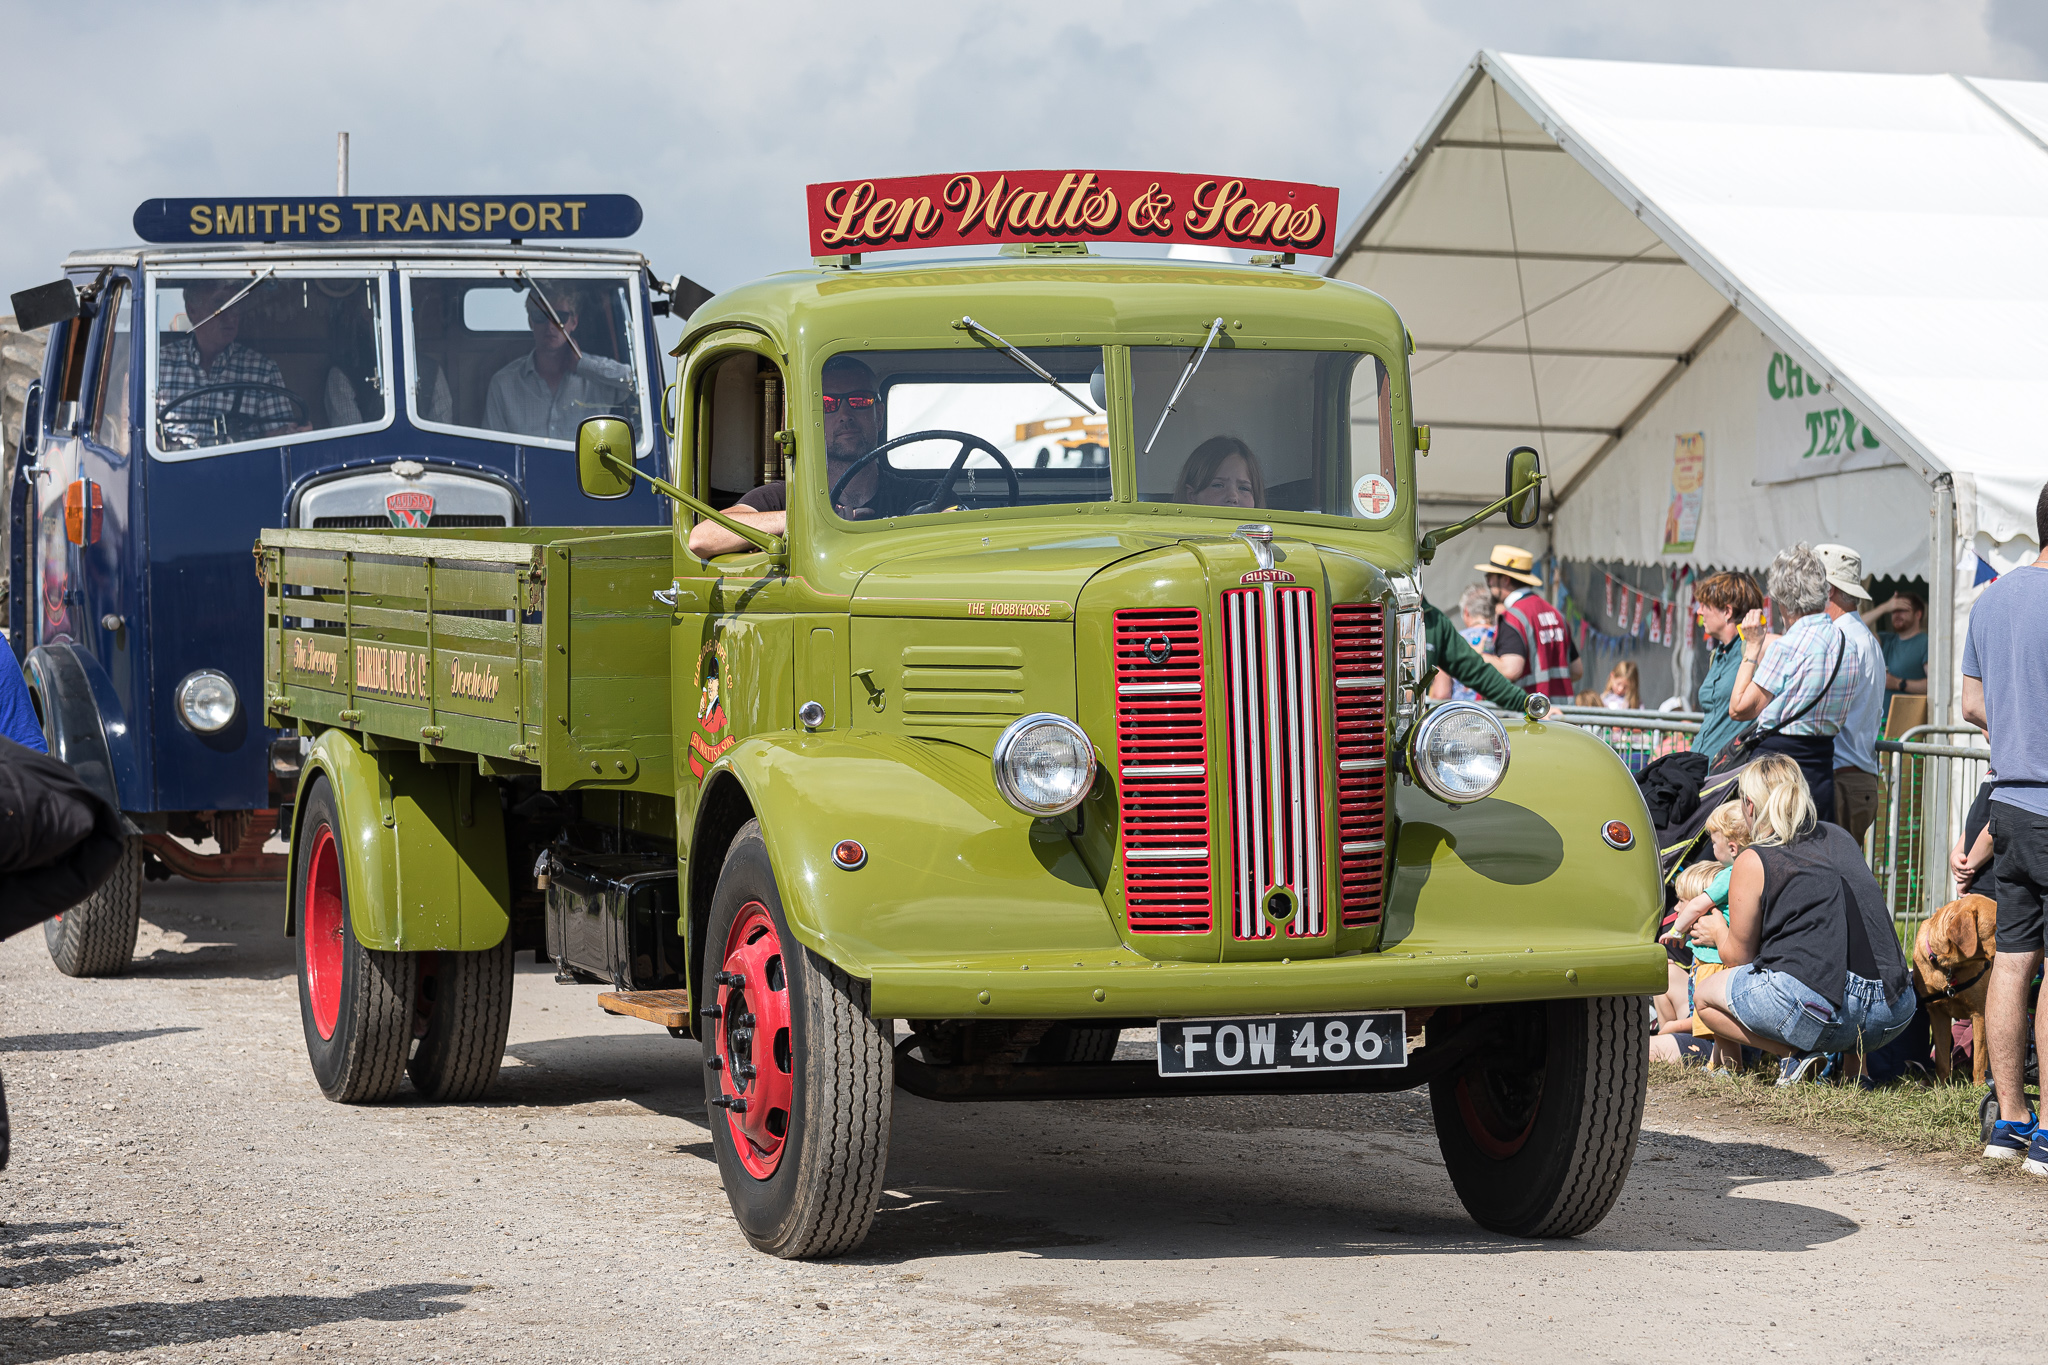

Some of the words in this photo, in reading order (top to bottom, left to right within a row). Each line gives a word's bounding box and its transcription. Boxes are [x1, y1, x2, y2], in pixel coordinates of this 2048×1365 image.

[189, 203, 342, 236] SMITH'S
[352, 202, 587, 233] TRANSPORT
[820, 182, 942, 244] Len
[943, 173, 1119, 236] Watts
[1127, 182, 1173, 232] &
[1184, 179, 1324, 244] Sons
[388, 494, 432, 508] MAUDSLAY
[1245, 570, 1291, 582] AUSTIN
[967, 603, 986, 616] THE
[990, 603, 1051, 617] HOBBYHORSE
[306, 637, 339, 686] Brewery
[714, 639, 727, 665] POPE
[356, 645, 388, 694] ELDRIDGE
[389, 649, 408, 698] POPE
[409, 651, 417, 698] &
[451, 656, 500, 703] Dorchester
[690, 733, 700, 749] LEN
[700, 740, 718, 761] WATTS
[721, 735, 735, 751] SONS
[1182, 1022, 1277, 1068] FOW
[1290, 1019, 1383, 1064] 486
